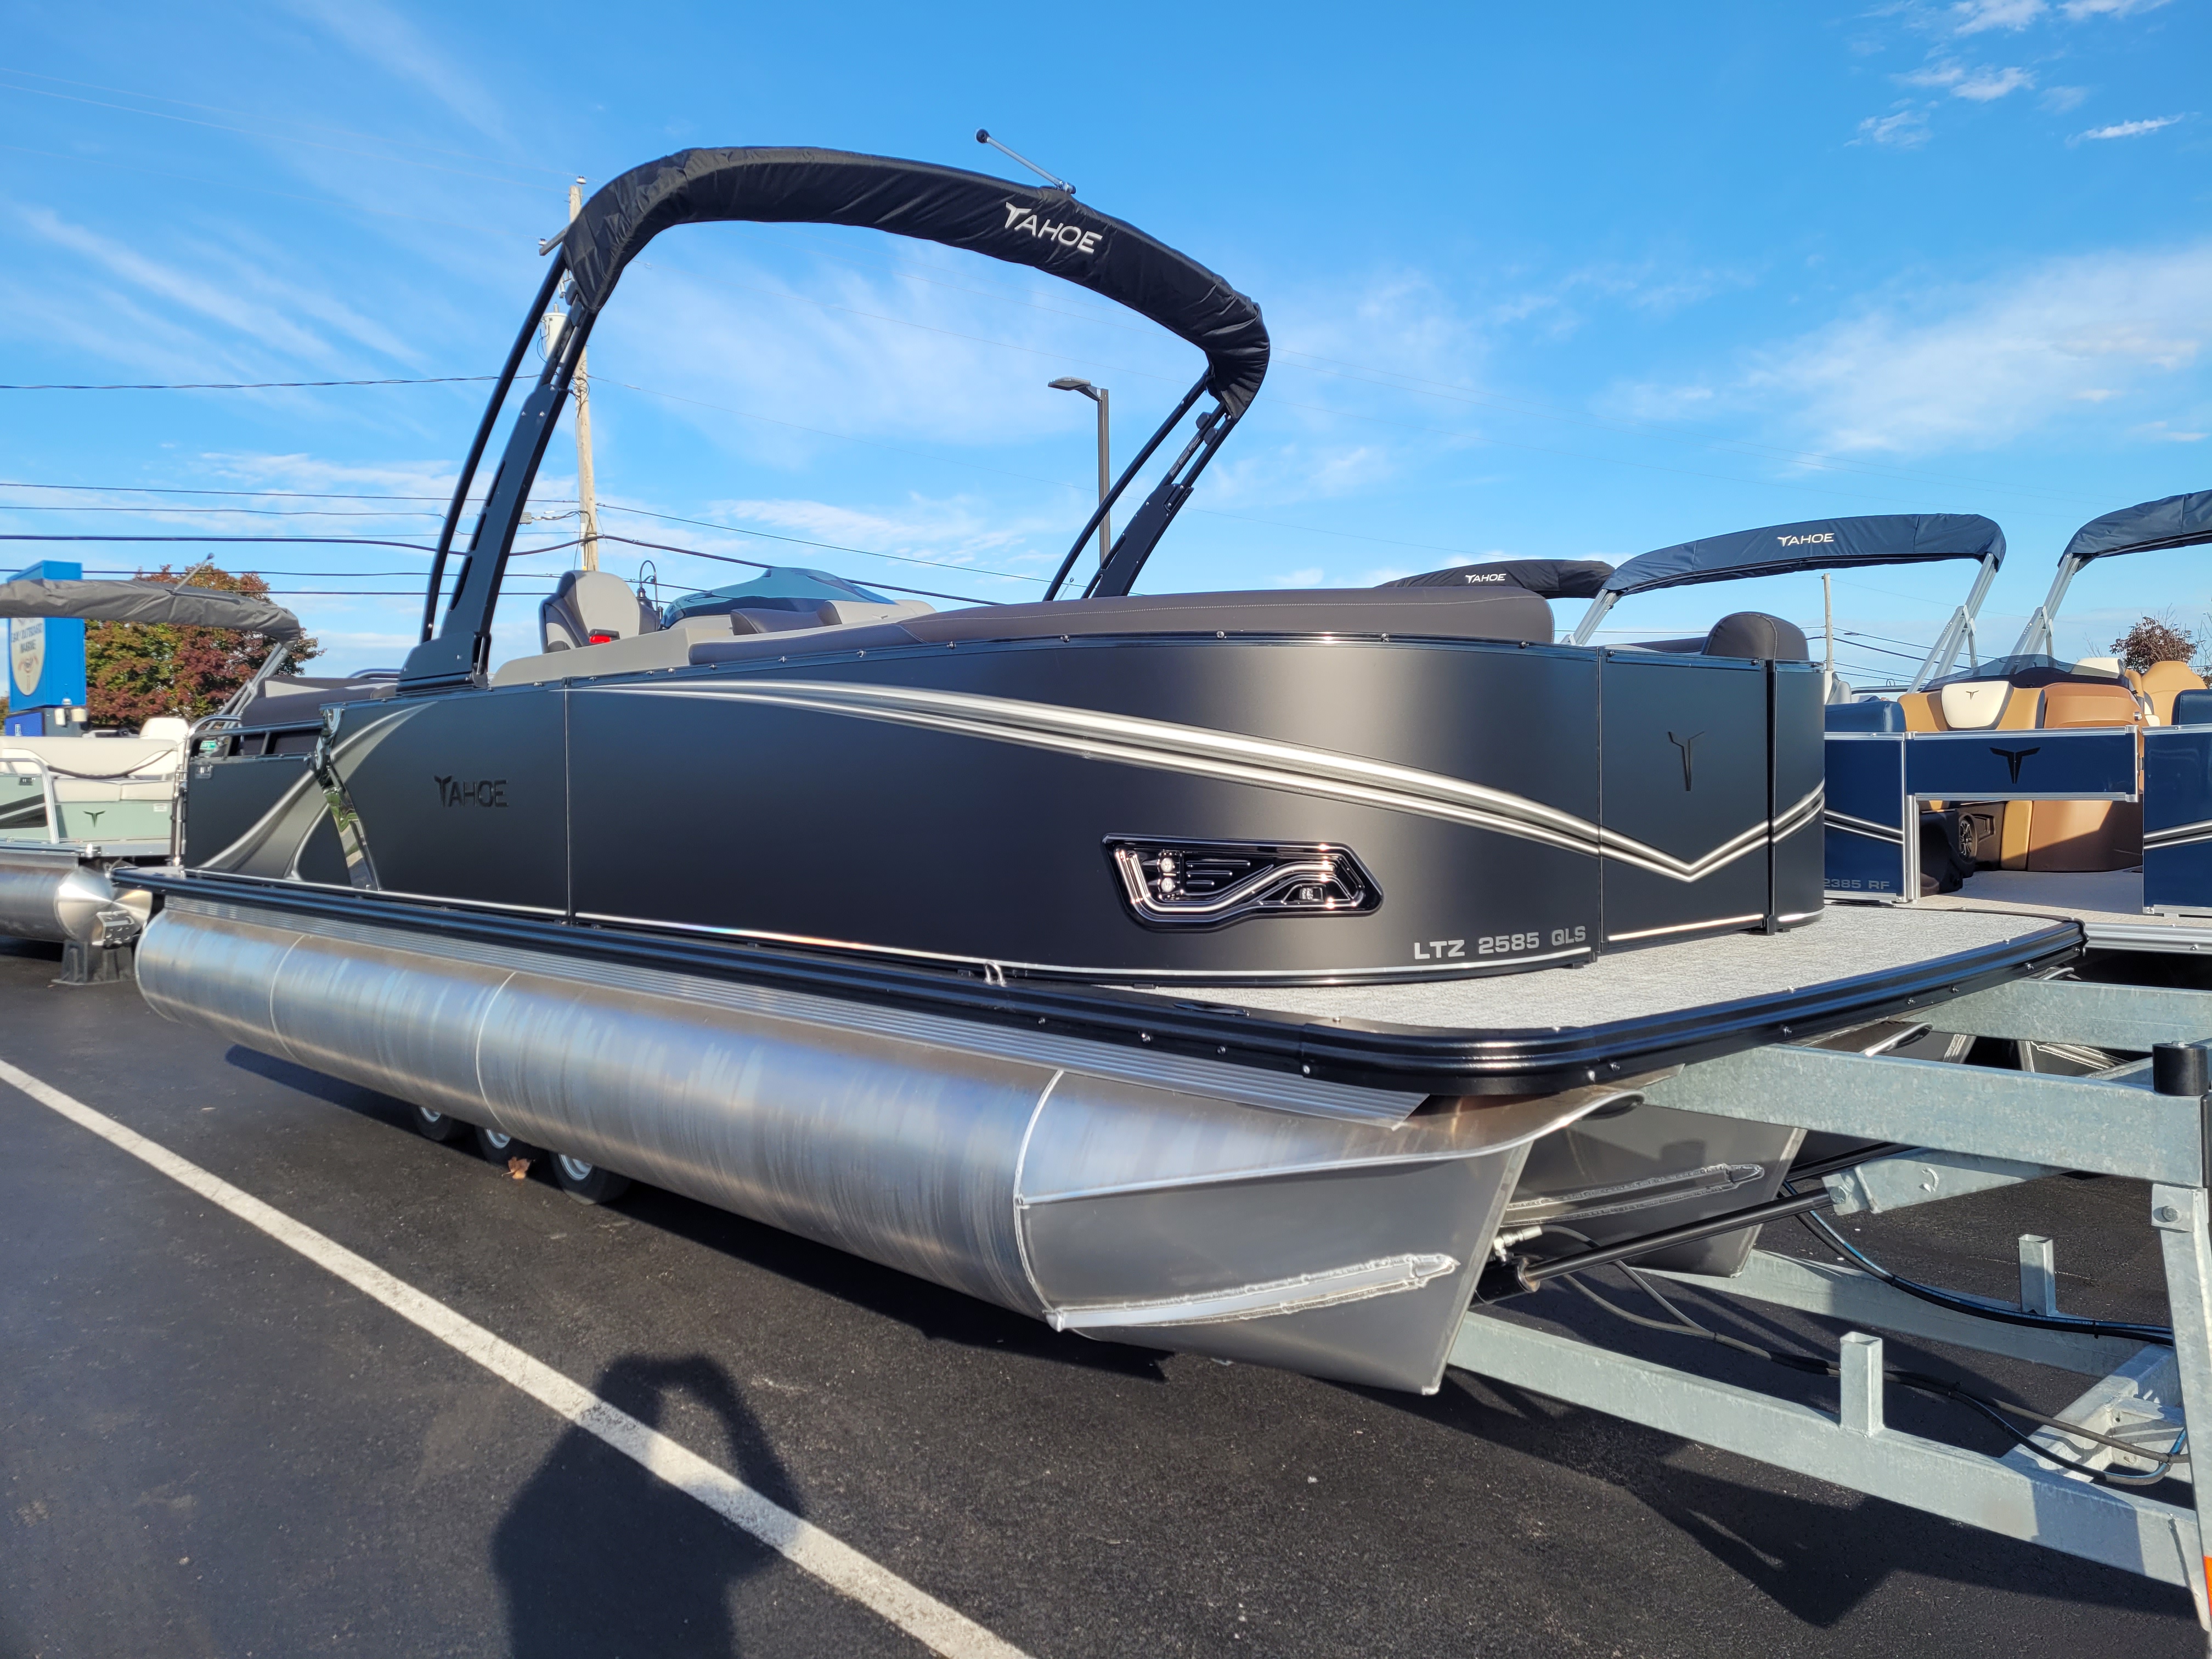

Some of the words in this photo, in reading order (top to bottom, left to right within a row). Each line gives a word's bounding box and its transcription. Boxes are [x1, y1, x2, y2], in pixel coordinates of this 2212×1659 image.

[1005, 201, 1103, 254] TAHOE
[1777, 533, 1835, 547] TAHOE
[1465, 573, 1507, 584] TAHOE
[434, 775, 509, 808] TAHOE
[1824, 878, 1861, 889] 2385
[1868, 880, 1890, 889] RF
[1414, 940, 1465, 960] LTZ
[1479, 932, 1539, 954] 2585
[1551, 926, 1586, 946] QLS
